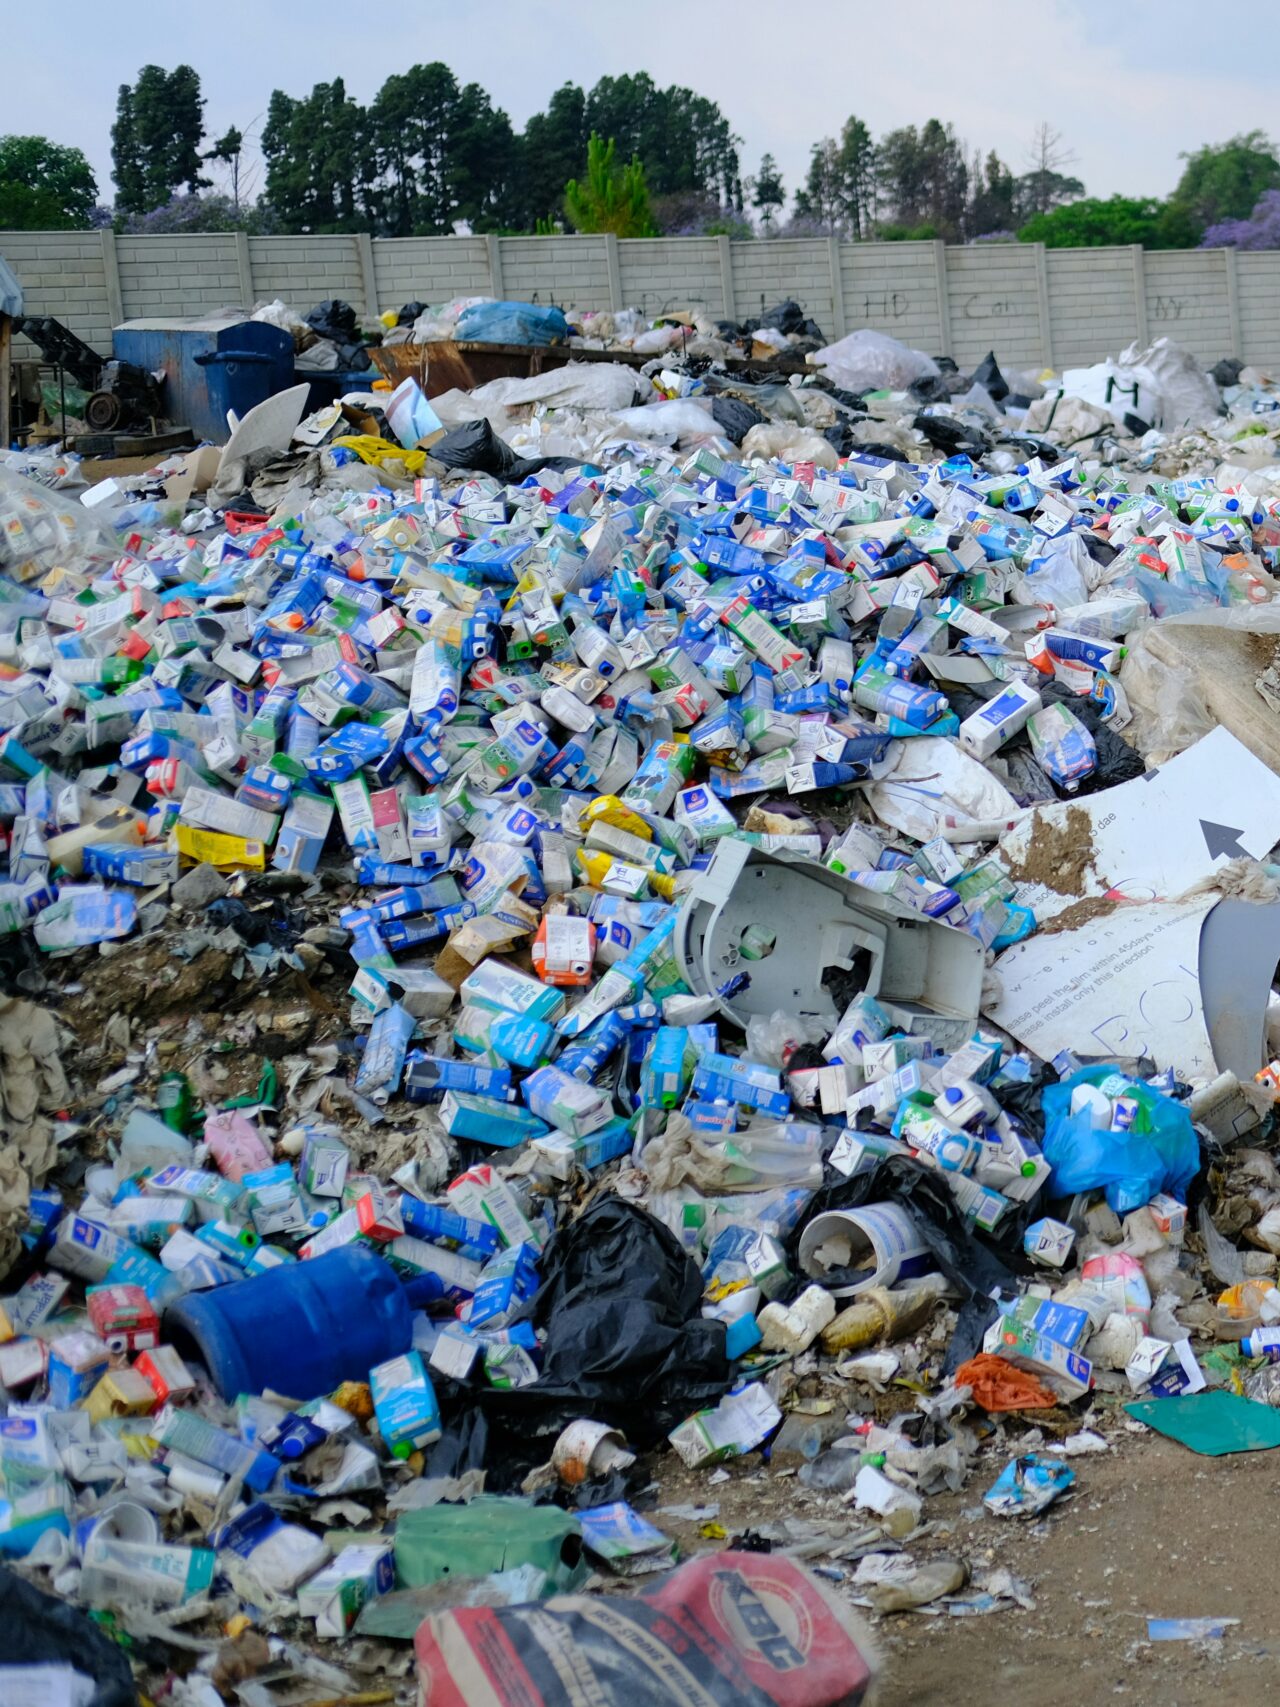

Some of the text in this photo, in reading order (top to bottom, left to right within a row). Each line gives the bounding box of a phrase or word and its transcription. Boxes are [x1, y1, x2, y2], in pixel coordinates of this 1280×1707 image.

[1098, 811, 1116, 830] dae
[1007, 1010, 1032, 1031] ease
[1033, 996, 1054, 1014] peel
[1055, 983, 1071, 998] the
[1072, 970, 1090, 986] film
[1091, 950, 1119, 973] within
[1154, 923, 1165, 934] of
[1020, 943, 1153, 1040] ease install only this direction
